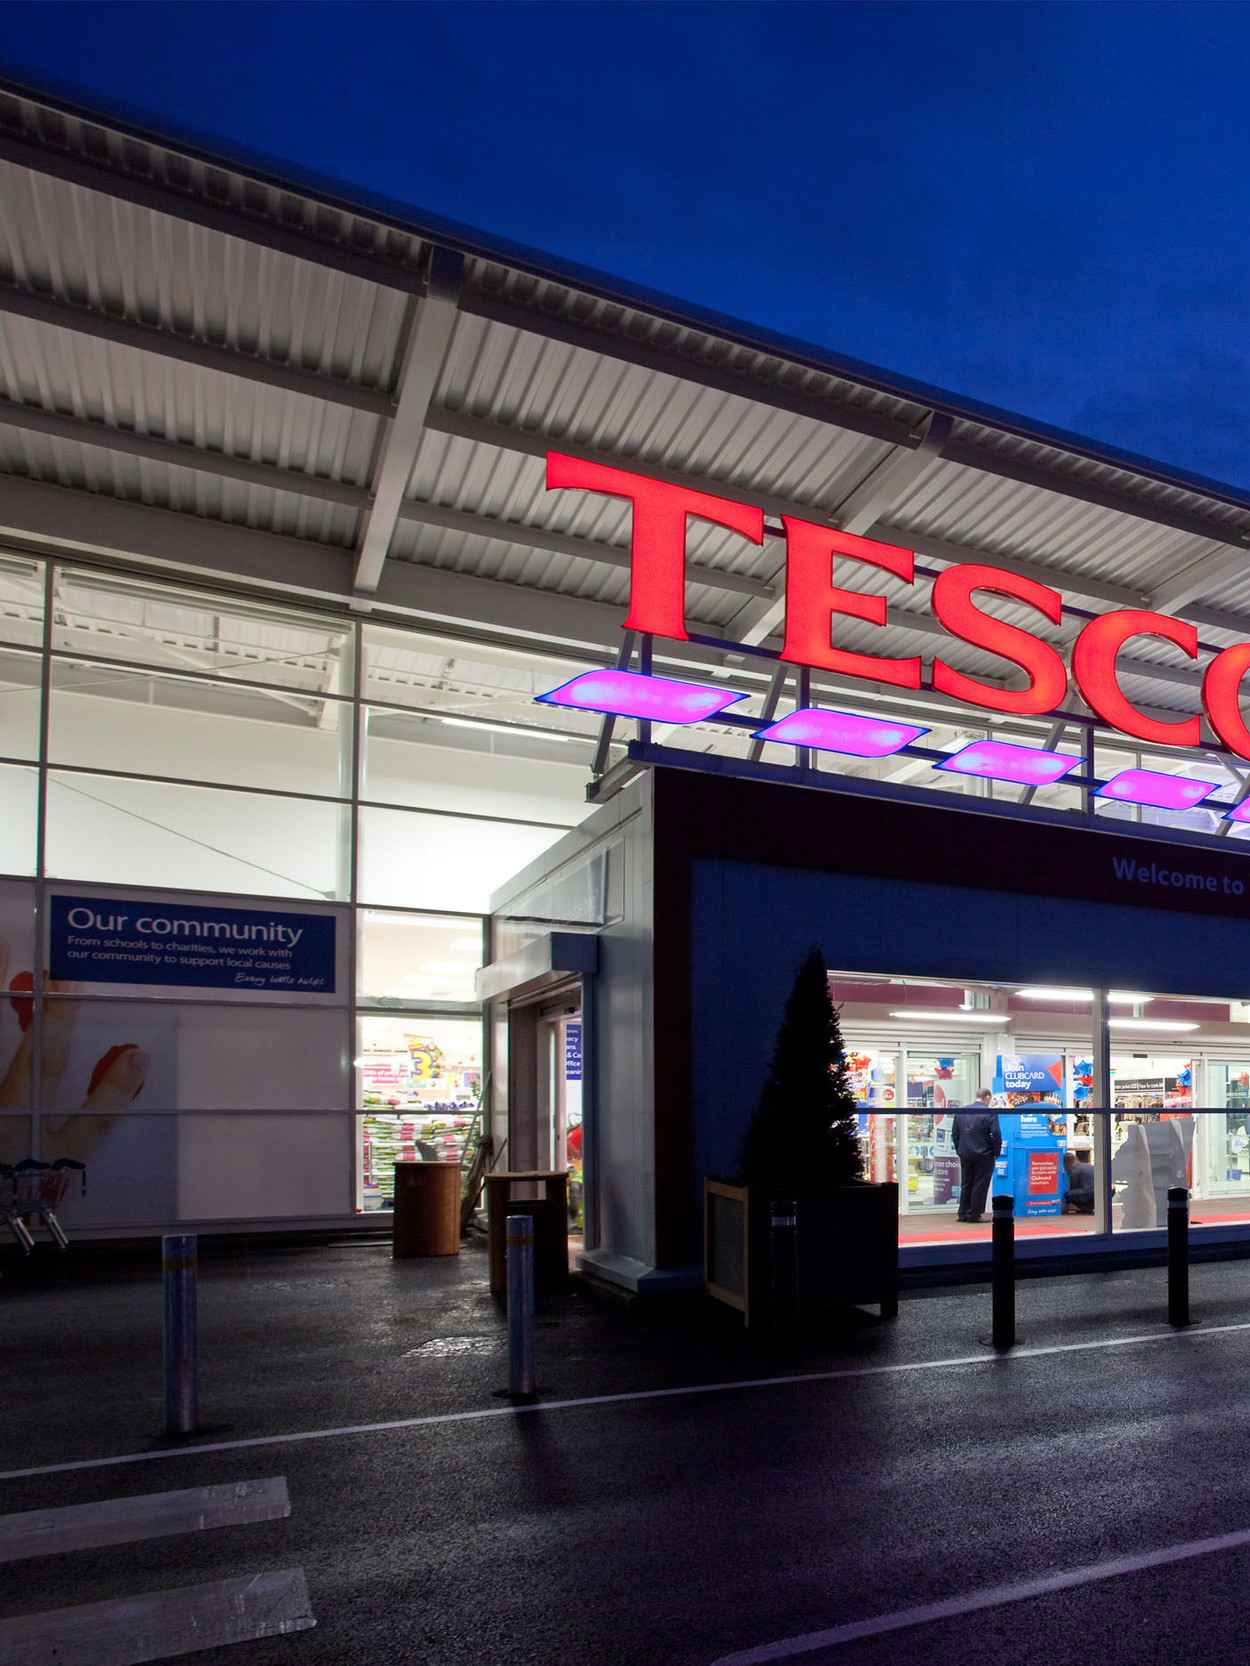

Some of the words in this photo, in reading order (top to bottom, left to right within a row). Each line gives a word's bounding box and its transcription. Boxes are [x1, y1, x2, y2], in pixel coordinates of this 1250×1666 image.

[1111, 857, 1218, 891] Welcome
[1222, 878, 1244, 896] to
[67, 907, 128, 932] Our
[135, 916, 304, 948] community
[67, 935, 101, 947] From
[103, 937, 148, 950] schools
[150, 941, 164, 951] to
[165, 941, 216, 955] charities,
[218, 946, 236, 956] we
[238, 945, 266, 957] work
[268, 947, 293, 959] with
[66, 950, 91, 960] our
[91, 951, 162, 965] community
[164, 955, 178, 964] to
[179, 955, 225, 969] support
[226, 956, 254, 968] local
[255, 960, 291, 970] causes
[234, 972, 266, 986] Every
[1004, 1071, 1045, 1080] CLUBCARD
[1005, 1063, 1025, 1072] Join
[1005, 1080, 1031, 1090] today
